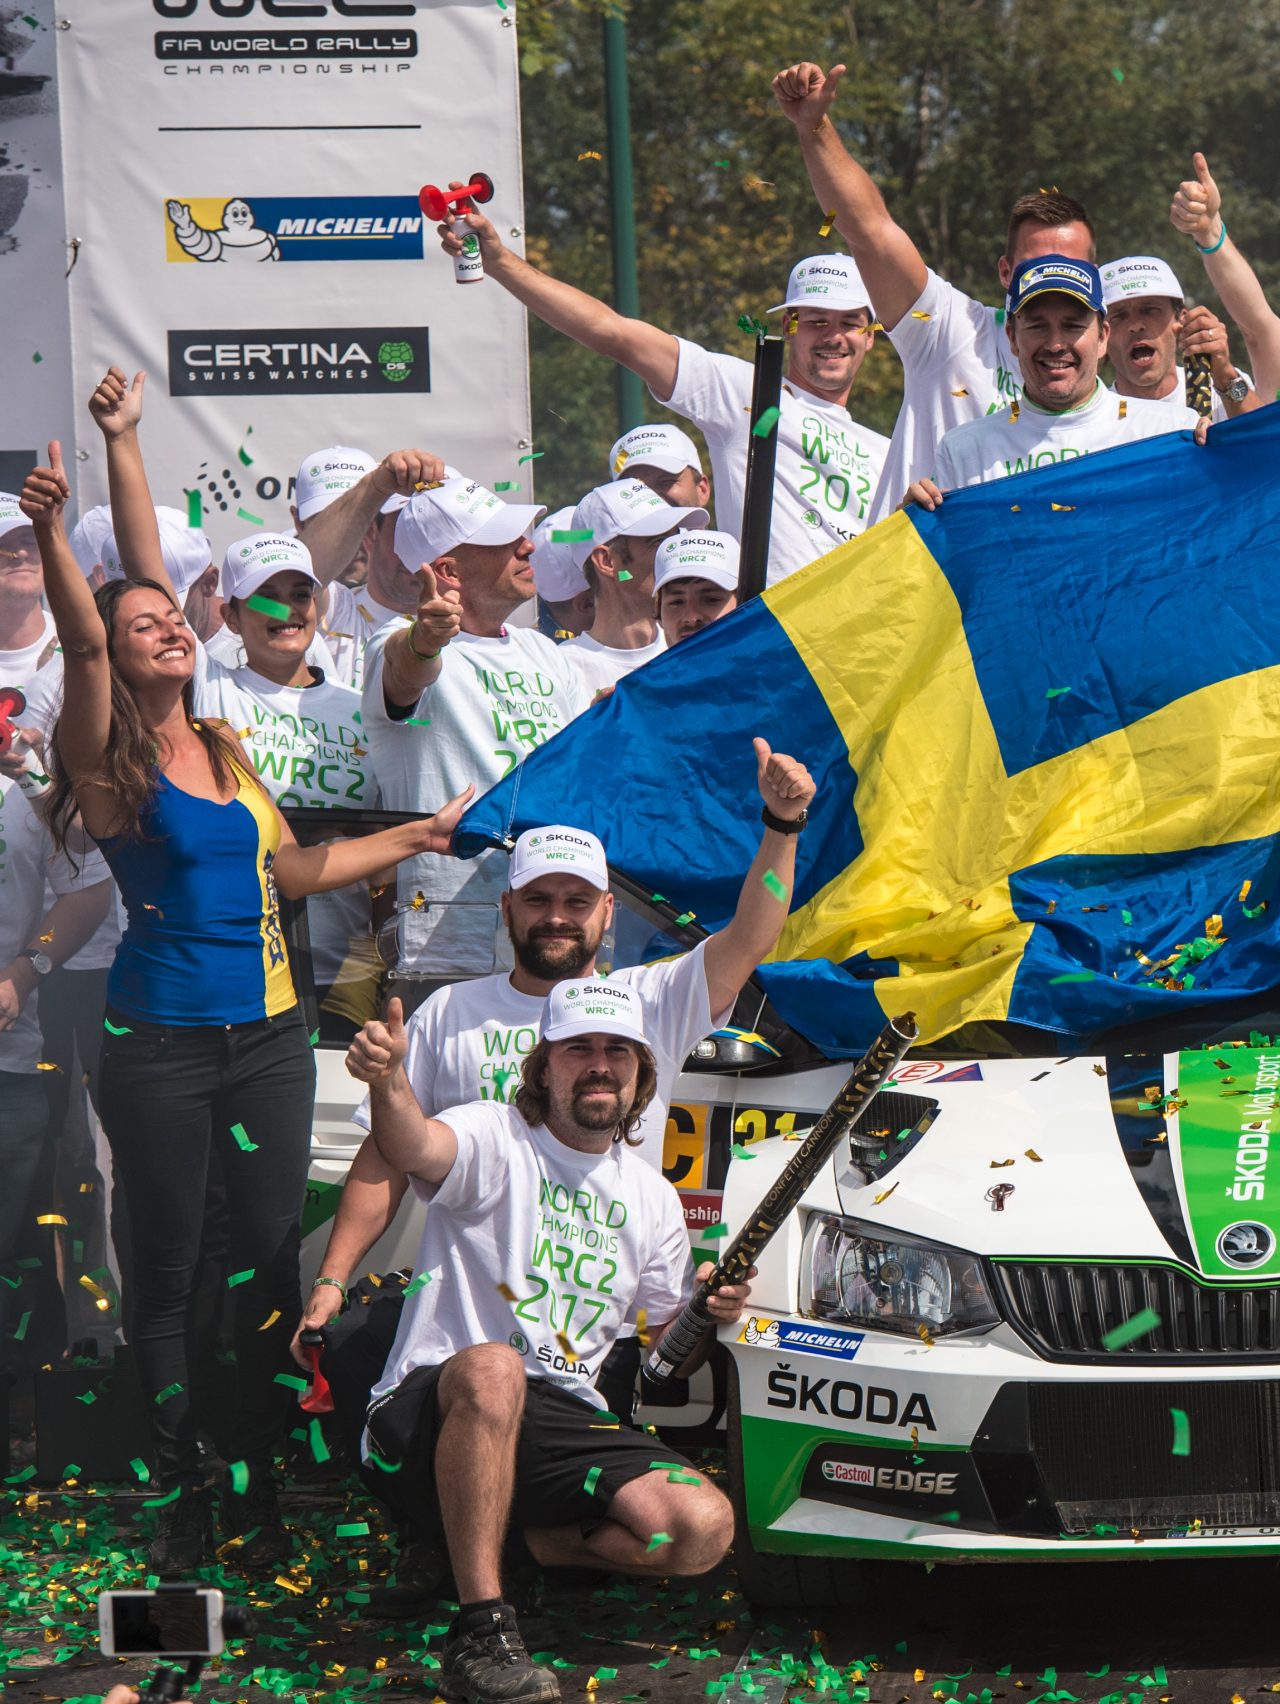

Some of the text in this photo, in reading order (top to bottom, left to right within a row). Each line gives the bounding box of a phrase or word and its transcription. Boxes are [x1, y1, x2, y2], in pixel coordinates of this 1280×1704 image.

[162, 35, 412, 52] FIA WORLD RALLY
[163, 63, 412, 76] CHAMPIONSHIP
[276, 216, 422, 236] MICHELIN
[808, 266, 848, 278] ŠKODA
[1118, 264, 1160, 274] ŠKODA
[1043, 265, 1091, 286] MICHELIN
[805, 286, 829, 294] WRC2
[1121, 281, 1148, 291] WRC2
[183, 342, 372, 366] CERTINA
[386, 362, 406, 371] DS
[188, 370, 370, 380] SWISS WATCHES
[627, 432, 667, 444] ŠKODA
[324, 463, 366, 473] ŠKODA
[325, 480, 351, 489] WRC2
[254, 539, 298, 549] ŠKODA
[679, 537, 725, 550] ŠKODA
[260, 553, 290, 564] WRC2
[679, 554, 706, 563] WRC2
[252, 748, 366, 801] WRC2
[546, 834, 592, 848] ŠKODA
[546, 852, 575, 861] WRC2
[583, 985, 630, 1001] ŠKODA
[585, 1007, 616, 1016] WRC2
[764, 1155, 803, 1209] CONFETTI
[800, 1109, 837, 1158] CANNON
[1225, 1118, 1271, 1201] ŠKODA
[784, 1329, 861, 1352] MICHELIN
[767, 1362, 937, 1432] ŠKODA
[834, 1463, 960, 1496] Castrol EDGE
